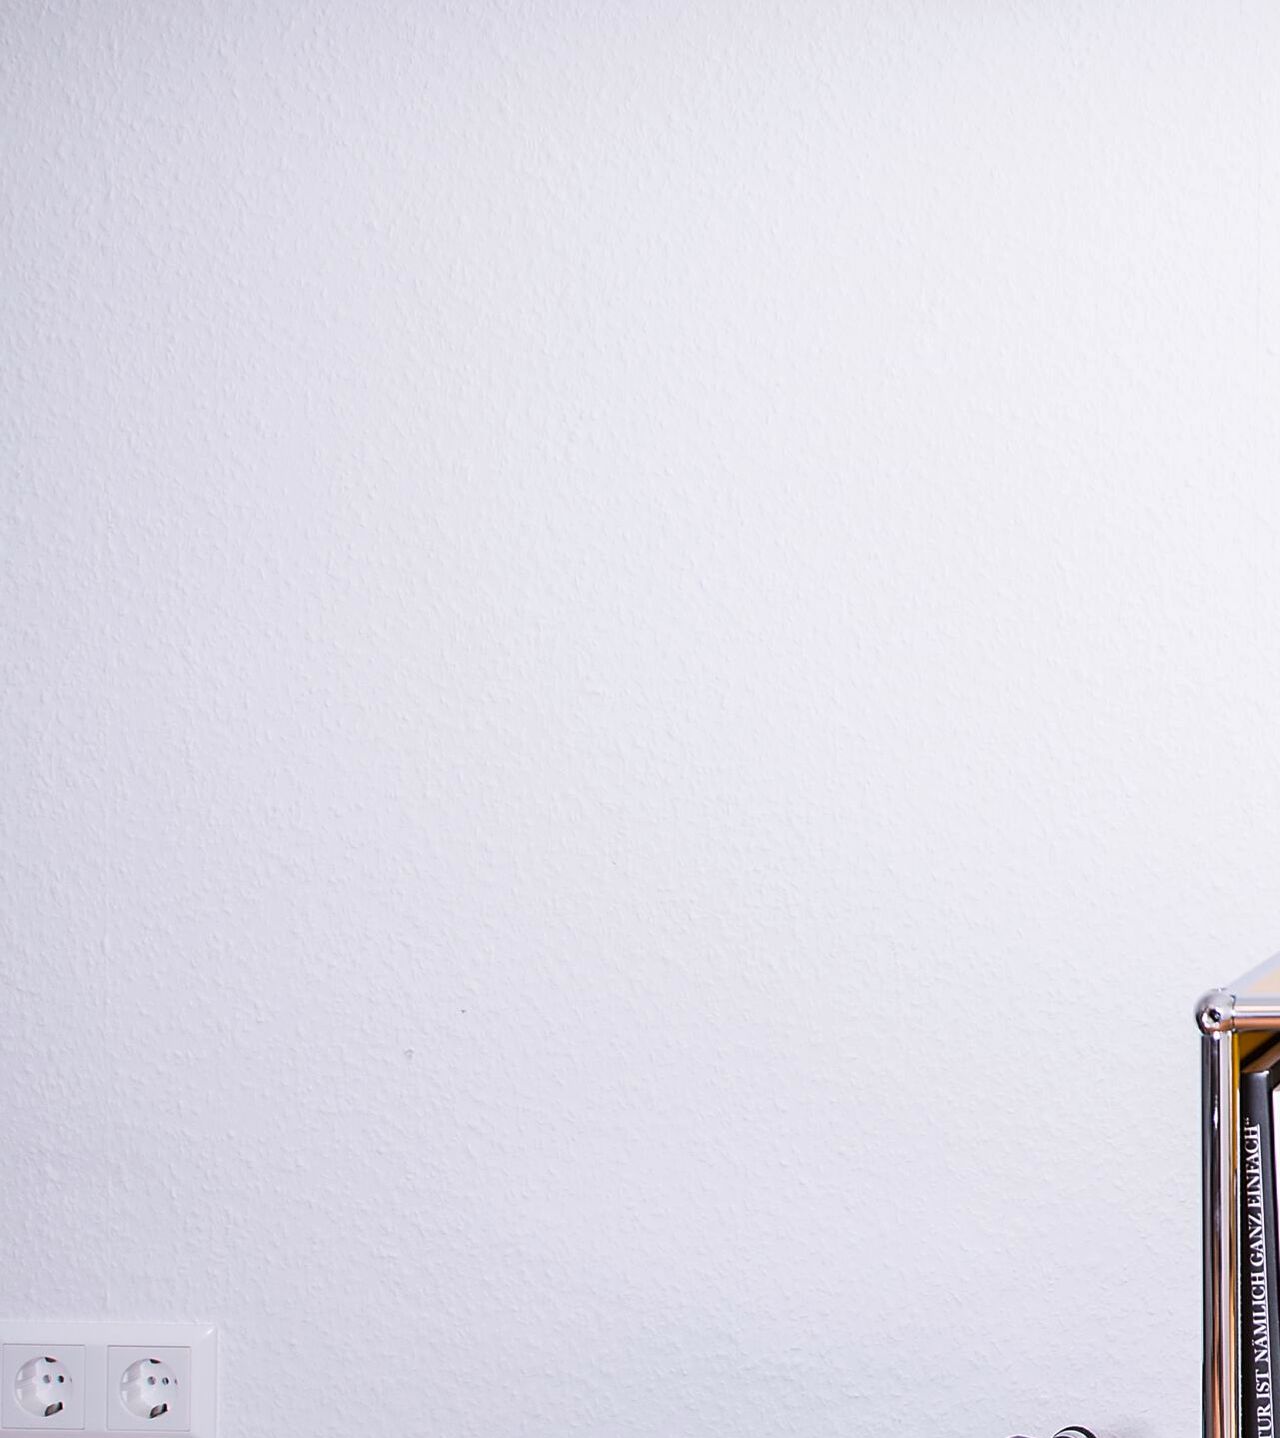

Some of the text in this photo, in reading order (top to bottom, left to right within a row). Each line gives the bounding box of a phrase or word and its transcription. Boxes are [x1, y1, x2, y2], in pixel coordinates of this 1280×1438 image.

[1248, 1213, 1266, 1267] GANZ
[1250, 1274, 1270, 1362] NÄMLICH
[1255, 1369, 1271, 1399] IST
